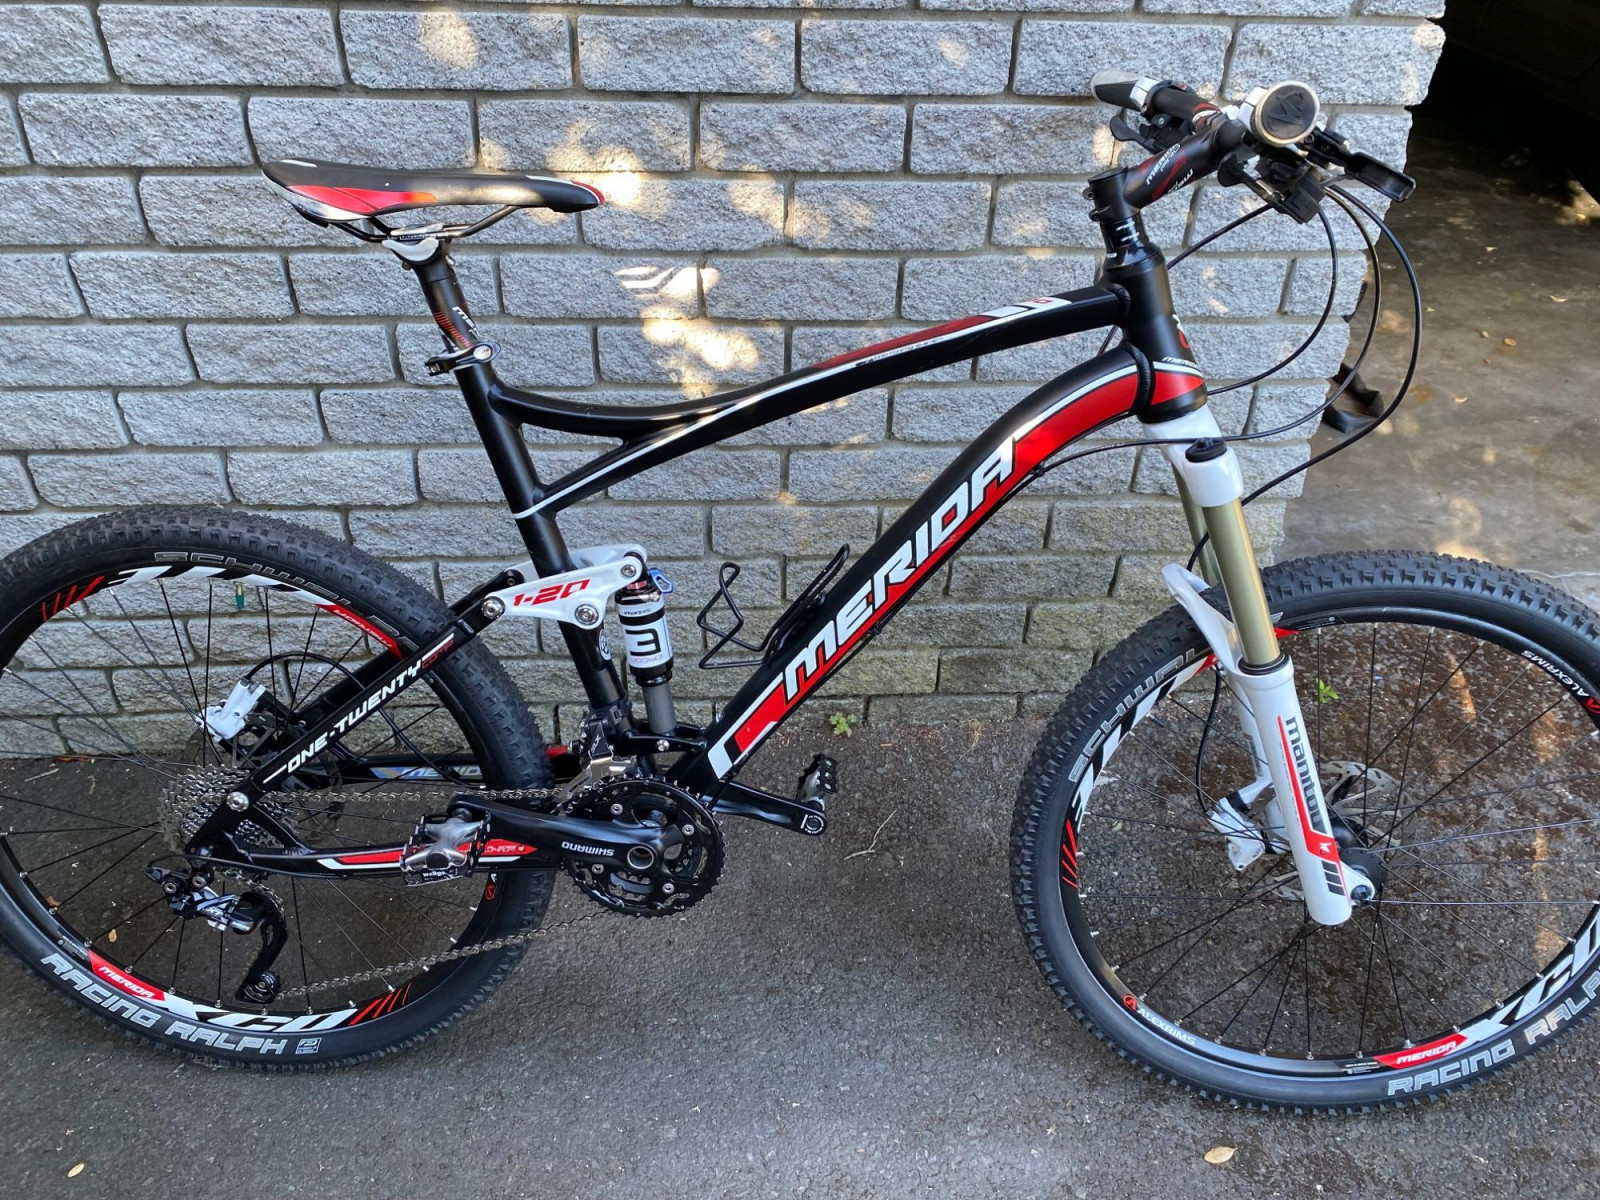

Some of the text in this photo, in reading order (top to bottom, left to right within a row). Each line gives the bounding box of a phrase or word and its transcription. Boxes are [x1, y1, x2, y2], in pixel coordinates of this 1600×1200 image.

[783, 435, 1015, 700] MERIDA
[513, 578, 591, 607] 1-20
[1521, 650, 1590, 697] ALEXRIMS
[1068, 647, 1201, 783] SCHWAL
[561, 841, 616, 857] SHIMANO
[40, 952, 288, 1055] RACING RALPH
[98, 966, 155, 999] MERIDA
[1137, 1008, 1197, 1046] ALEXRIMS
[1387, 965, 1600, 1096] RACING RALP
[1396, 1040, 1458, 1065] MERIDA
